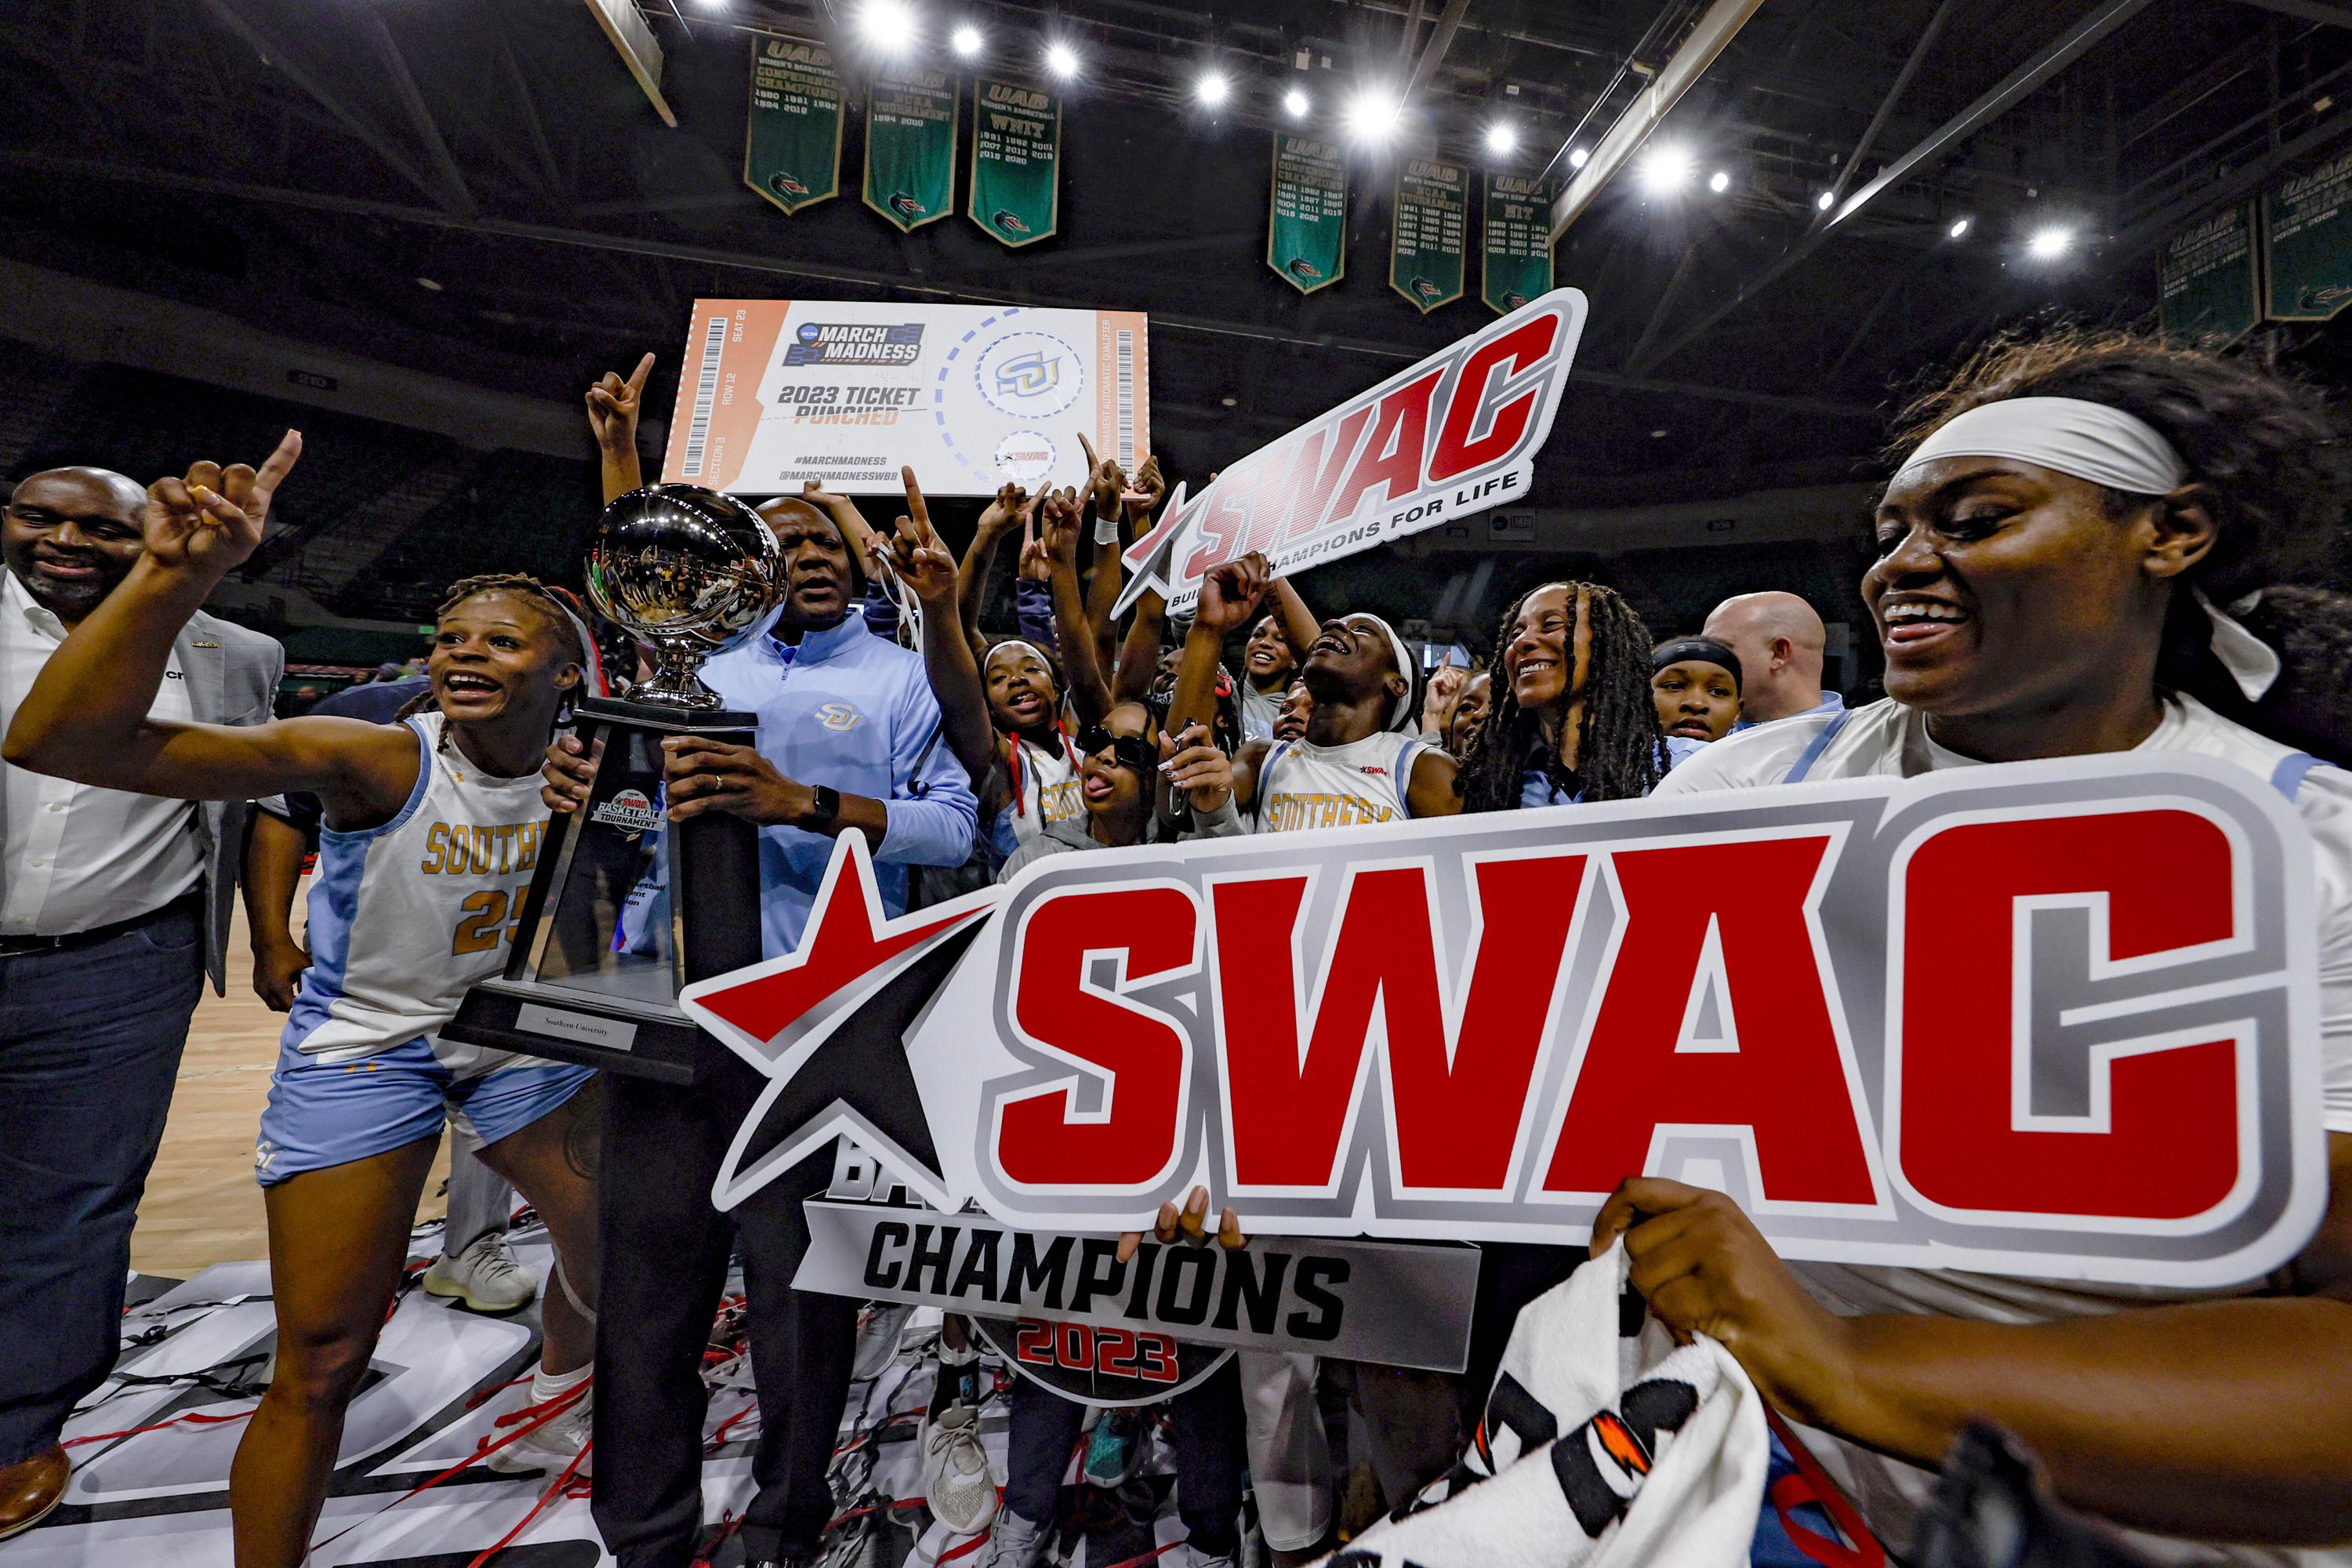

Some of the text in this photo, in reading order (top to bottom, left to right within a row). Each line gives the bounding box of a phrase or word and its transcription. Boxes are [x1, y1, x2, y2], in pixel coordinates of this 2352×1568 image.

[768, 41, 831, 66] UAB
[756, 75, 837, 100] CHAMPIONS
[989, 85, 1049, 110] UAB
[875, 101, 950, 122] TOURNAMENT
[981, 99, 1054, 119] WOMEN'S BASKETBALL
[990, 113, 1045, 138] WNIT
[1286, 138, 1339, 160] UAB
[1278, 171, 1343, 190] CHAMPIONS
[1279, 161, 1343, 180] CONFERENCE
[1408, 160, 1458, 182] UAB
[1399, 192, 1463, 212] TOURNAMENT
[1417, 184, 1446, 200] NCAA
[1505, 205, 1534, 220] NIT
[732, 309, 746, 343] SEAT 23
[818, 326, 888, 343] MARCH
[1102, 319, 1111, 360] QUALIFIER
[824, 343, 917, 359] MADNESS
[995, 350, 1063, 397] SU
[722, 372, 736, 406] ROW 12
[778, 386, 921, 405] 2023 TICKET
[1102, 361, 1111, 411] AUTOMATIC
[793, 406, 900, 426] PUNCHED
[1185, 314, 1559, 579] SWAC
[708, 445, 724, 485] SECTION
[794, 456, 887, 466] #MARCHMADNESS
[779, 471, 898, 481] @MARCHMADNESSWBB
[1268, 521, 1380, 571] HAMPIONS
[1391, 499, 1444, 529] FOR
[1456, 471, 1520, 506] LIFE
[597, 801, 662, 821] BASKETBALL
[622, 797, 648, 809] SWAC
[601, 813, 657, 829] TOURNAMENT
[998, 808, 2239, 1220] SWAC
[546, 1017, 608, 1036] Southern University
[863, 1221, 1351, 1341] CHAMPIONS
[1017, 1317, 1179, 1384] 2023
